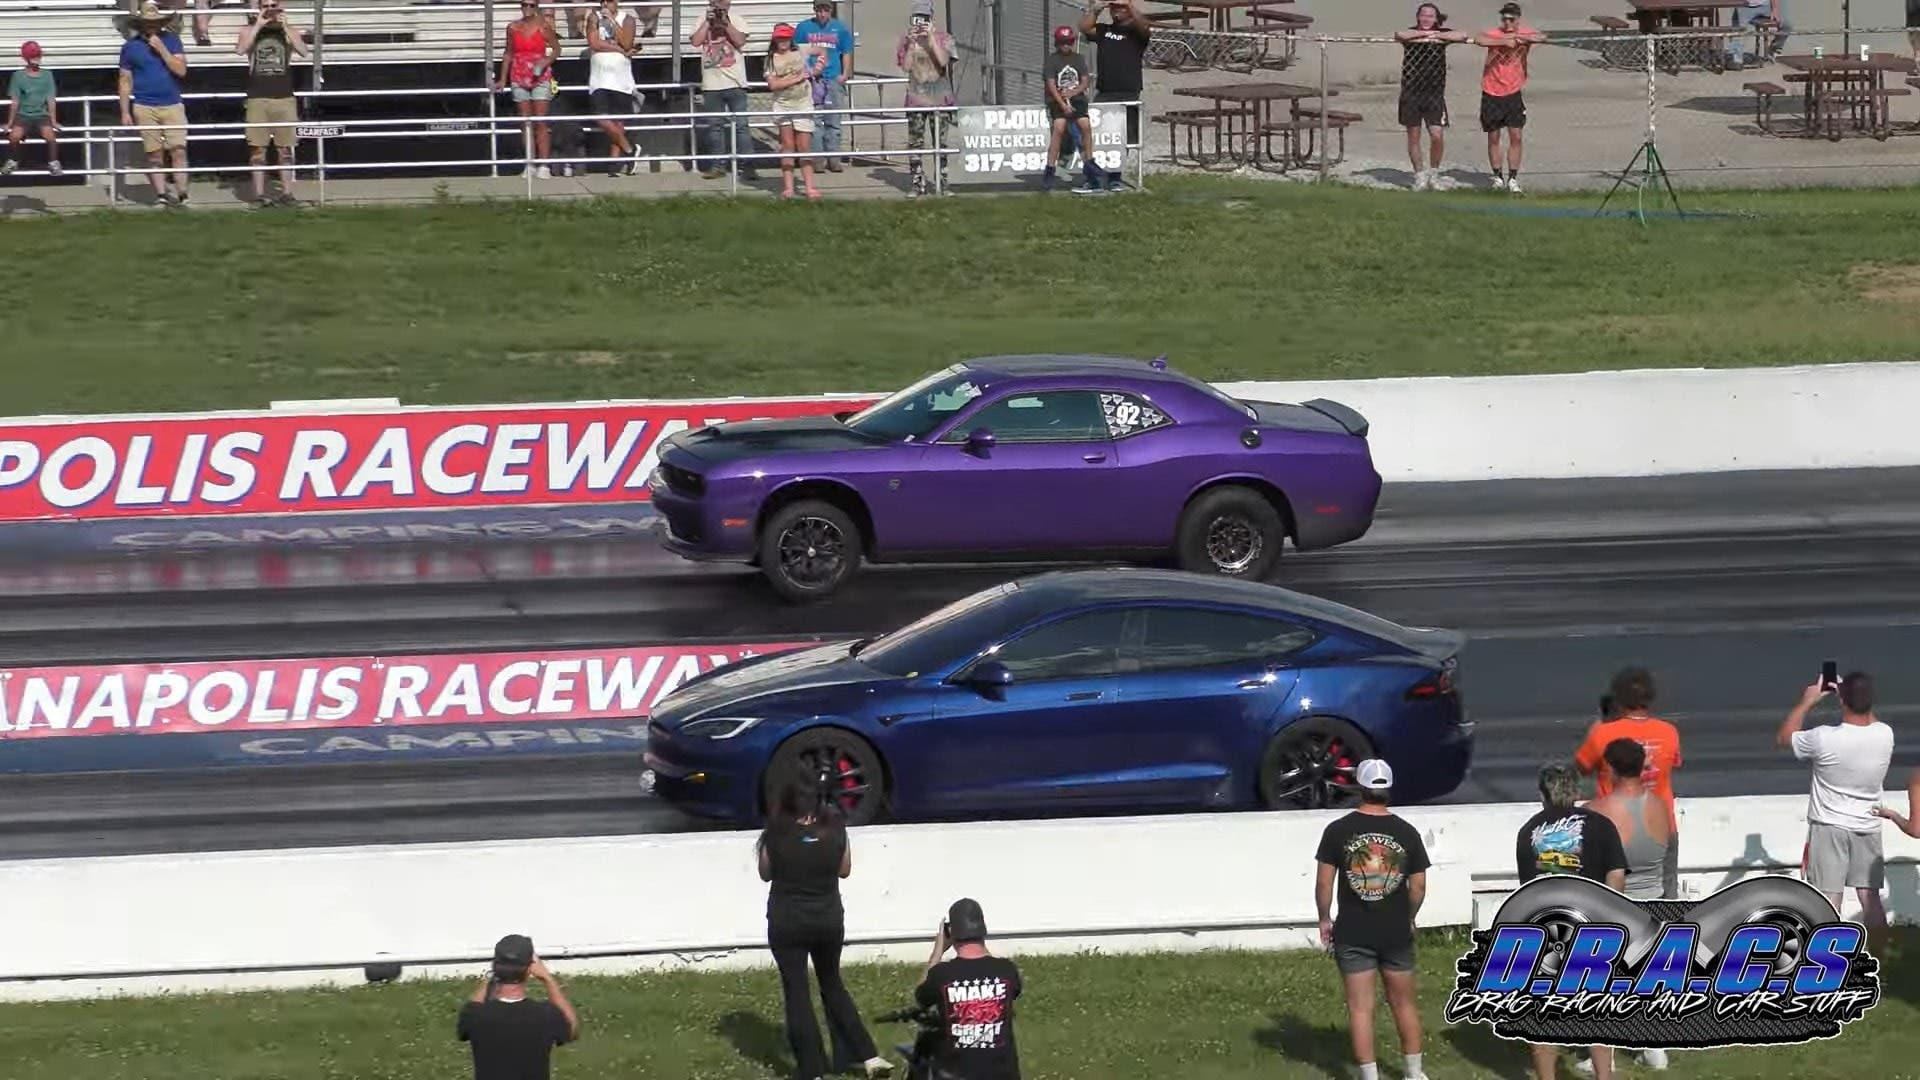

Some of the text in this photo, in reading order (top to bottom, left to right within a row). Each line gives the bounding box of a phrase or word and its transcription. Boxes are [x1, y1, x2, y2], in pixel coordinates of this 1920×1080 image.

[964, 134, 1046, 149] WRECKER
[1116, 405, 1141, 425] 92
[279, 417, 772, 500] RACEWA
[0, 653, 762, 731] NAPOLIS RACEWA
[240, 727, 649, 756] CAMPIN
[1347, 836, 1370, 852] KEY
[1371, 835, 1405, 853] WEST
[947, 983, 1007, 1003] MAKE
[951, 1021, 1004, 1037] GREAT
